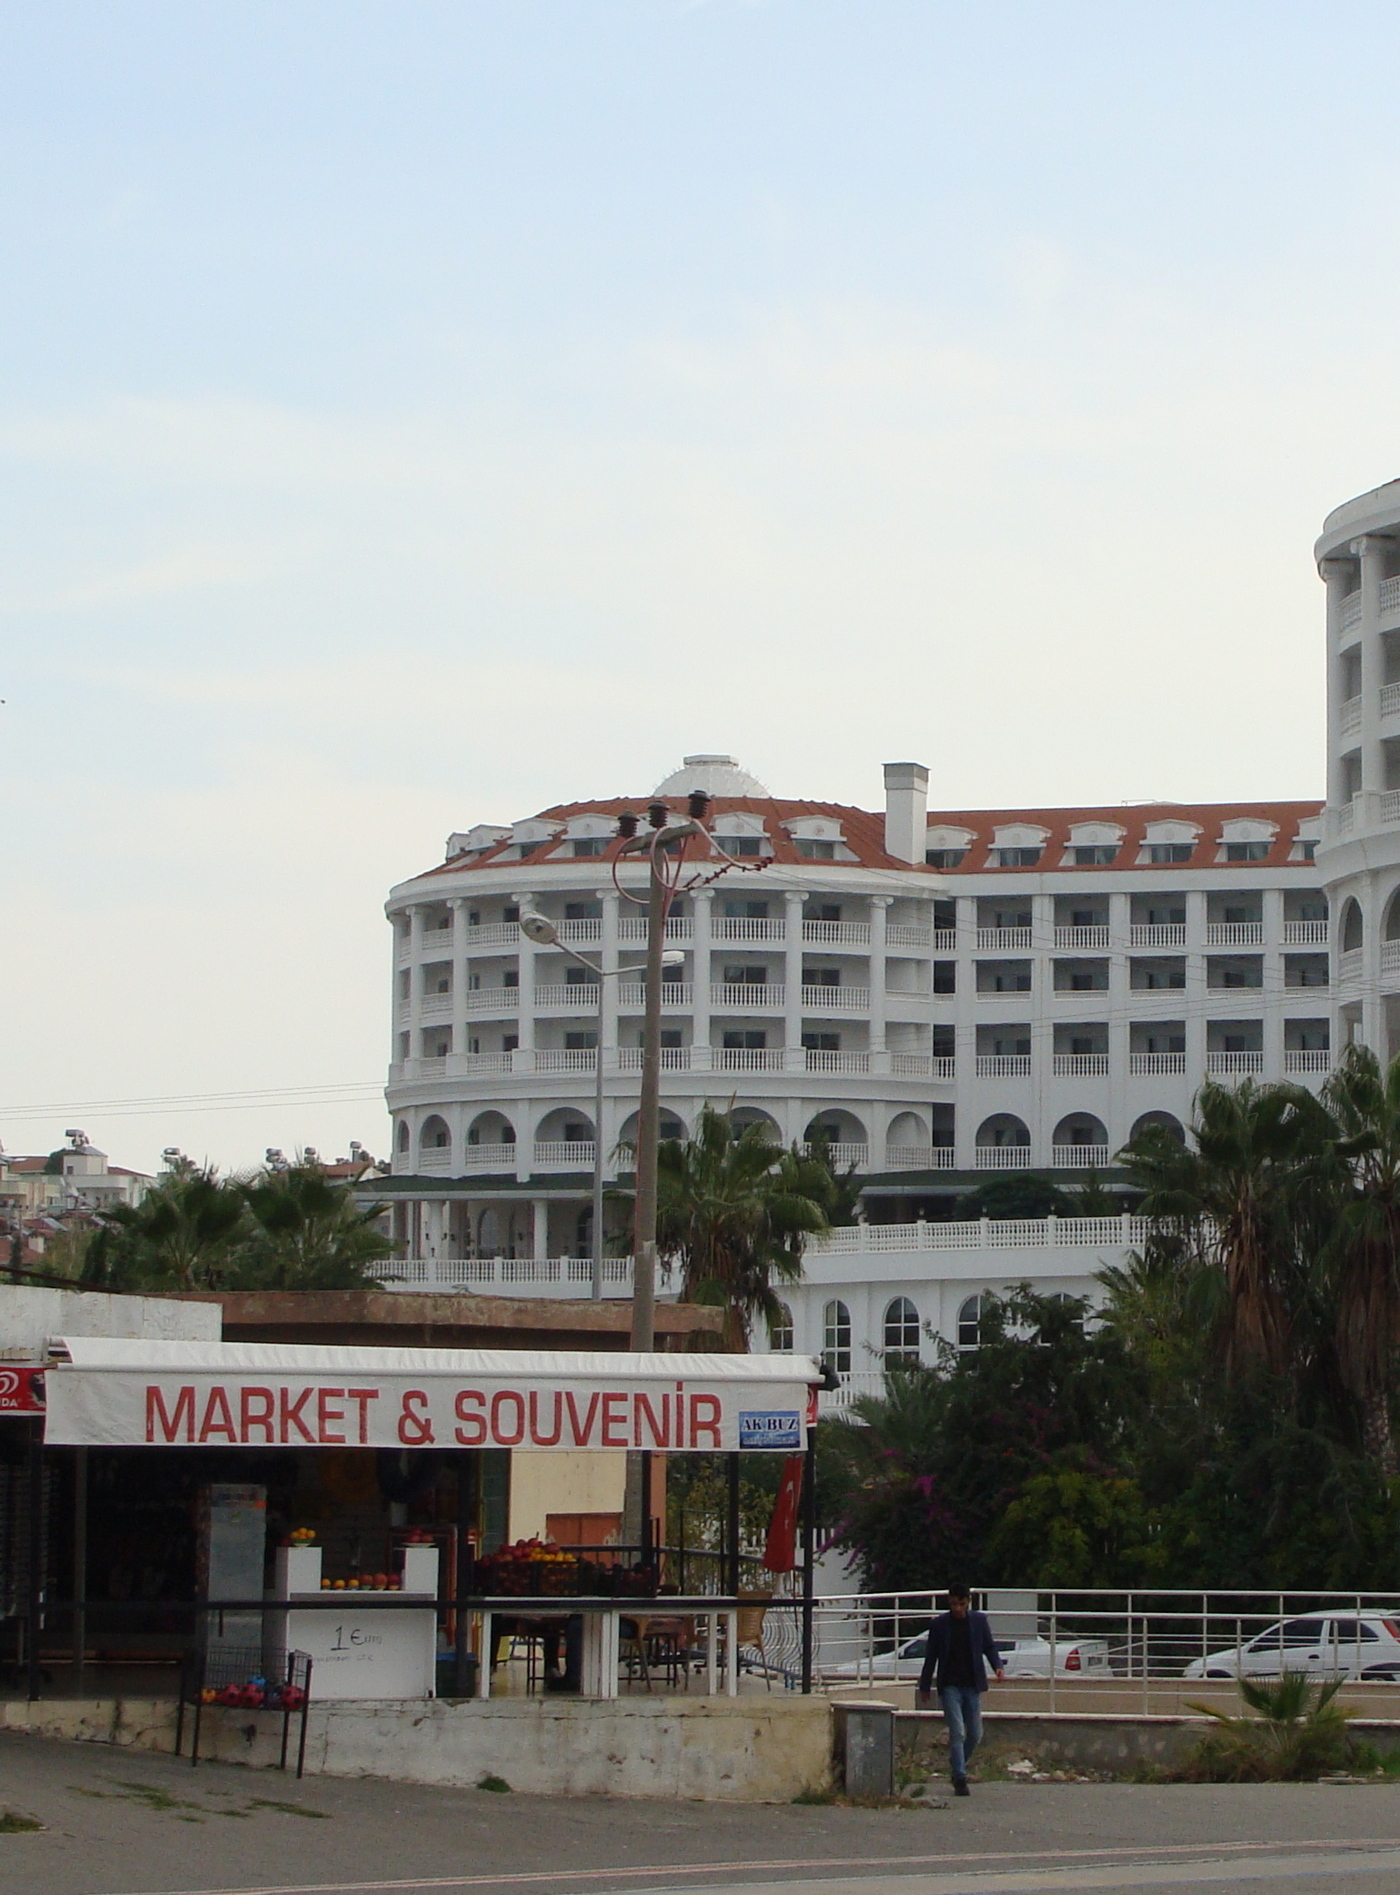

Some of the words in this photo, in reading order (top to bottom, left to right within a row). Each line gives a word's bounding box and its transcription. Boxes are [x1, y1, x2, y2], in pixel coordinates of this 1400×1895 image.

[0, 1397, 18, 1407] DA
[145, 1385, 380, 1444] MARKET
[397, 1389, 436, 1446] &
[742, 1418, 762, 1431] AK
[766, 1418, 797, 1431] BUZ
[331, 1625, 350, 1651] 1
